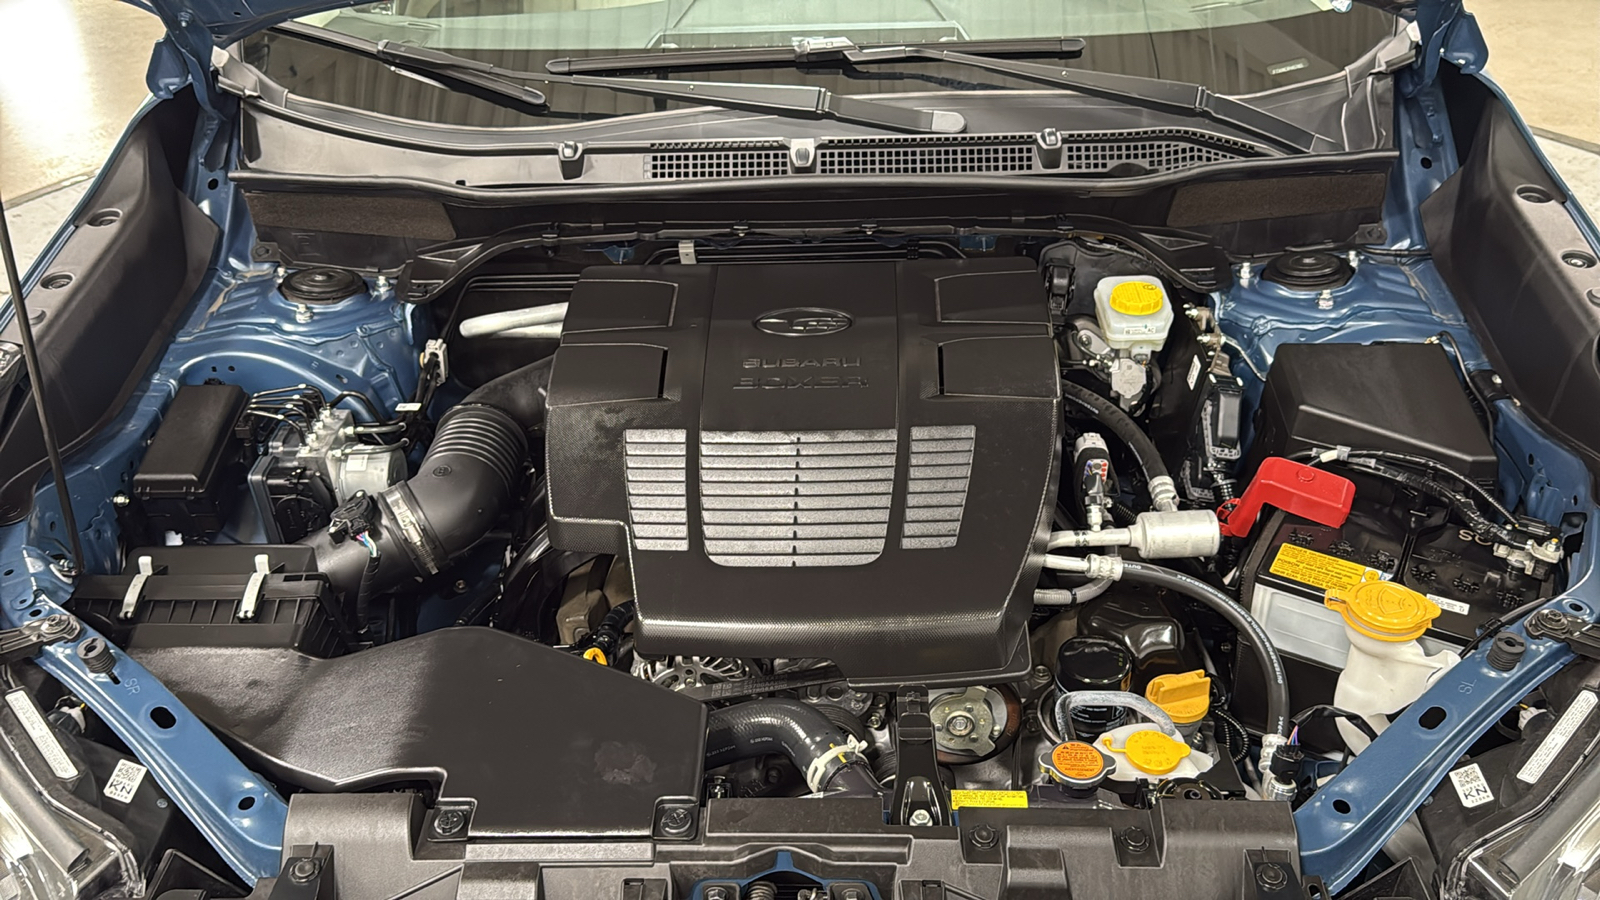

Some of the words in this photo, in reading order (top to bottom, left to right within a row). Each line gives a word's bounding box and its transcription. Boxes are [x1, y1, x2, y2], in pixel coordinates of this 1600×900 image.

[743, 357, 861, 368] SUBARU
[733, 376, 869, 390] BOXER
[124, 677, 140, 696] SR
[1458, 679, 1477, 695] SL
[109, 781, 132, 796] KN
[1463, 786, 1488, 800] KN
